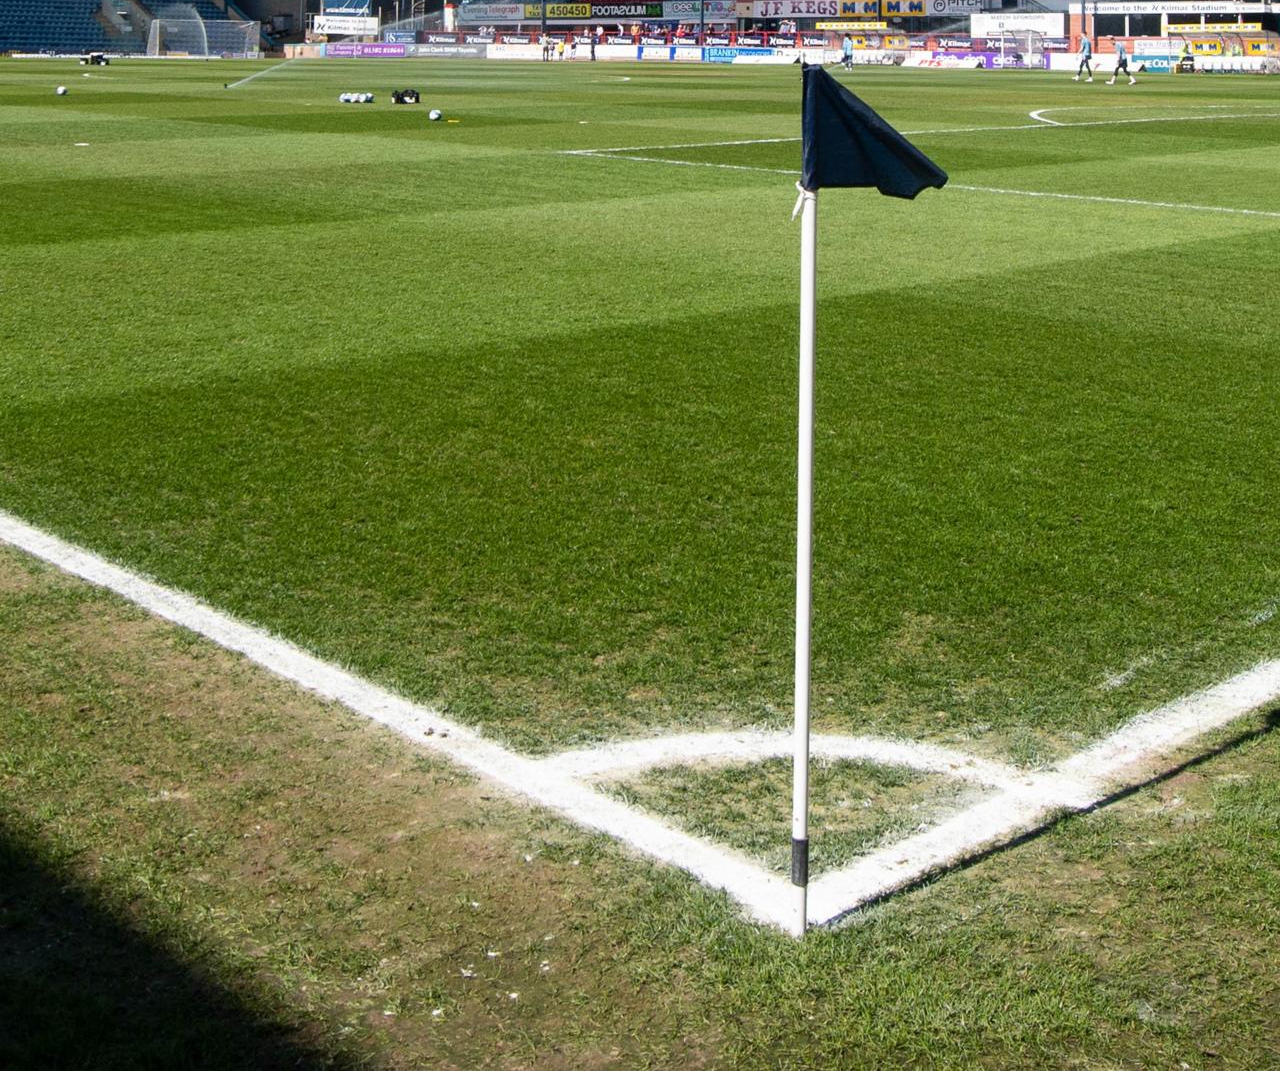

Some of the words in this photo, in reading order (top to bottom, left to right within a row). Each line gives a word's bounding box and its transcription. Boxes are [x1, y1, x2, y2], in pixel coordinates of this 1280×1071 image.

[549, 5, 587, 16] 450450
[592, 5, 647, 16] FOOTASYLUM
[790, 0, 837, 16] KEGS
[842, 1, 878, 14] MKM
[886, 0, 923, 13] MKM
[709, 48, 739, 57] BRANKIN
[1195, 43, 1217, 51] MKM
